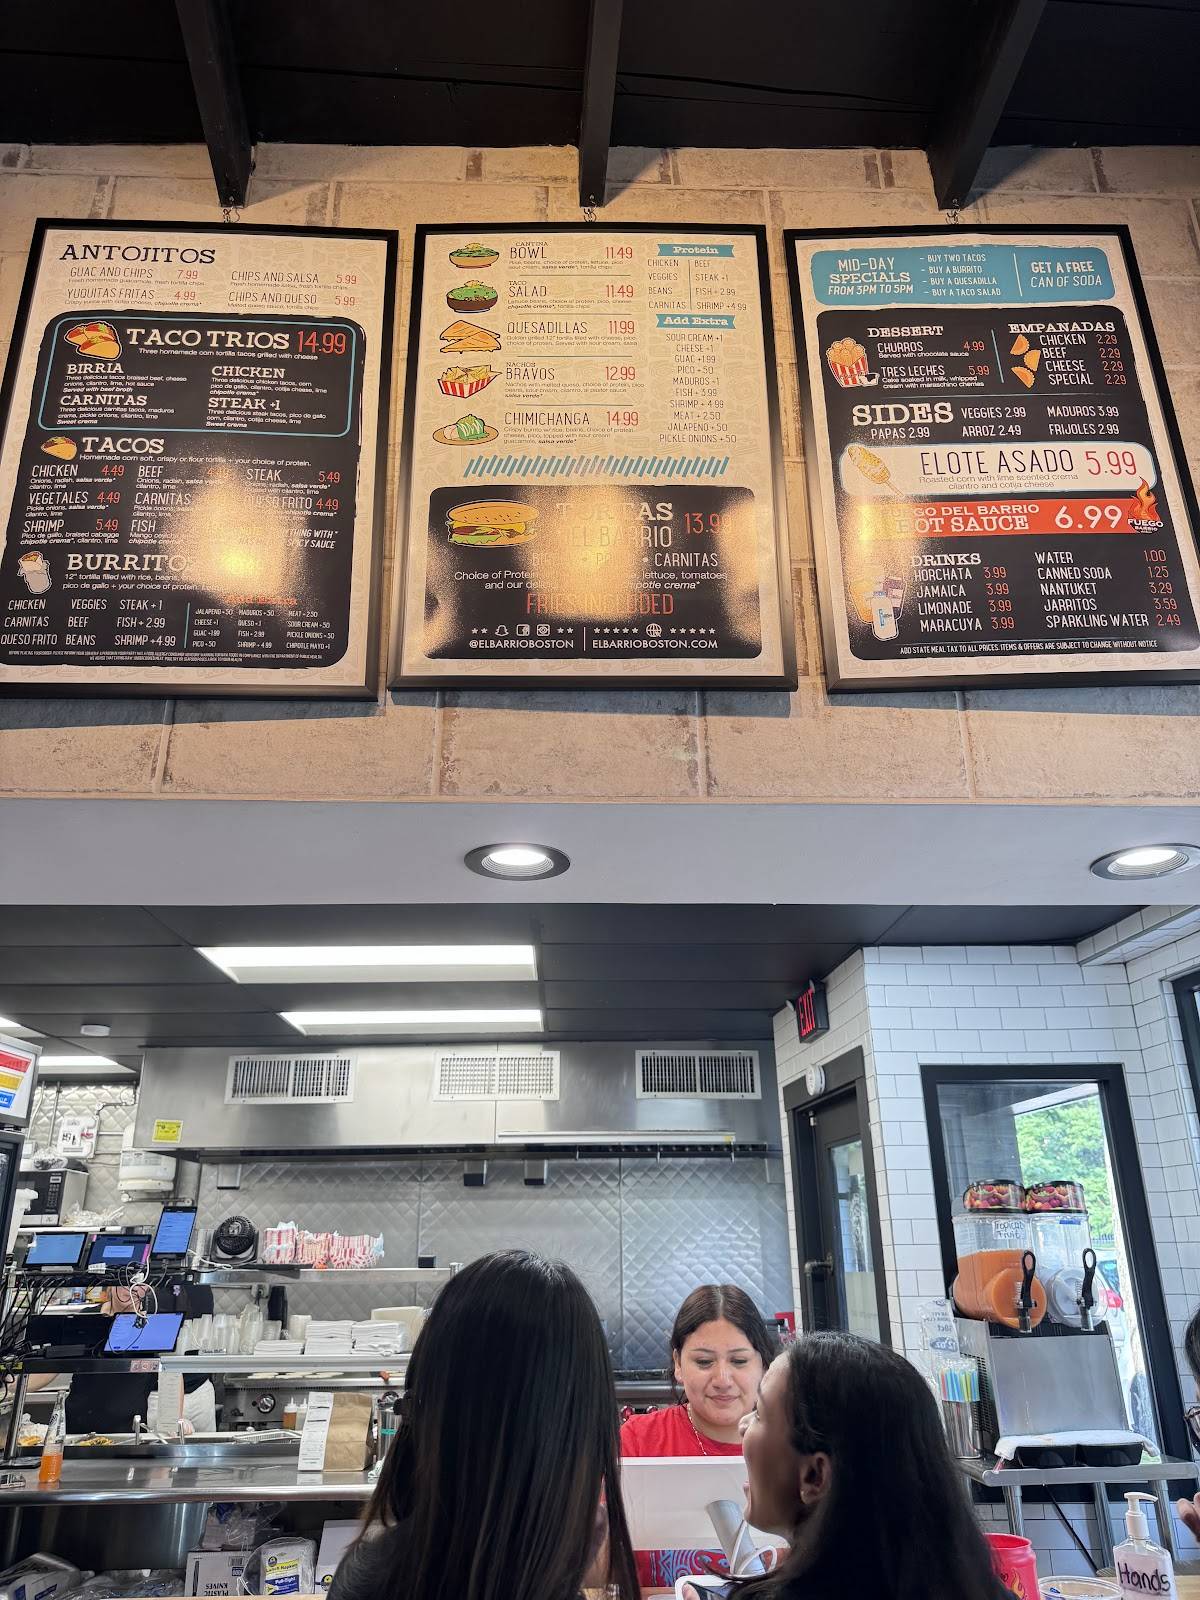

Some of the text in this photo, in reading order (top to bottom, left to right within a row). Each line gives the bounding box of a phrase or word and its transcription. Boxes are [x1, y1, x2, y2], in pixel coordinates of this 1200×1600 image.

[60, 245, 215, 263] ANTOJITOS
[510, 247, 547, 259] BOWL
[963, 254, 986, 262] TACOS
[838, 257, 894, 271] MID-DAY
[929, 266, 943, 274] BUY
[953, 266, 982, 274] BURRITO
[1031, 261, 1094, 273] GET A FREE
[70, 267, 198, 279] GUAC AND CHIPS 7.99
[231, 271, 357, 284] CHIPS AND SALSA 5.99
[830, 272, 911, 284] SPECIALS
[955, 277, 997, 285] QUESADILLA
[1031, 275, 1102, 288] CAN OF SODA
[119, 289, 196, 300] FRITAS 4.99
[508, 286, 547, 298] SALAD
[828, 285, 913, 295] FROM 3PM TO 5PM
[978, 288, 1001, 296] SALAD
[229, 292, 317, 304] CHIPS AND QUESO
[507, 321, 634, 334] QUESADILLAS 11.99
[867, 326, 943, 337] DESSERT
[1008, 322, 1115, 333] EMPANADAS
[127, 329, 346, 354] TACO TRIOS 14.99
[1040, 334, 1117, 345] CHICKEN 2.29
[878, 341, 984, 353] CHURROS 4.99
[1043, 348, 1120, 358] BEEF 2.29
[67, 363, 124, 374] BIRRIA
[212, 366, 285, 378] CHICKEN
[881, 365, 989, 377] TRES LECHES 5.99
[1046, 360, 1123, 372] CHEESE 2.29
[506, 366, 636, 380] BRAVOS 12.99
[1048, 373, 1126, 385] SPECIAL 2.29
[673, 377, 710, 385] MADUROS
[60, 395, 147, 406] CARNITAS
[208, 398, 266, 409] STEAK
[852, 402, 954, 426] SIDES
[961, 407, 1026, 418] VEGGIES 2.99
[1047, 406, 1119, 417] MADUROS 3.99
[504, 412, 639, 426] CHIMICHANGA 14.99
[871, 427, 930, 439] PAPAS 2.99
[962, 425, 1021, 436] ARROZ 2.49
[1049, 424, 1119, 435] FRIJOLES 2.99
[82, 437, 164, 454] TACOS
[921, 450, 1136, 476] ELOTE ASADO 5.99
[32, 465, 124, 477] CHICKEN 4.49
[138, 466, 164, 477] BEEF
[246, 469, 340, 483] STEAK 5.49
[29, 492, 120, 504] VEGETALES 4.49
[283, 497, 312, 510] FRITO
[942, 504, 1039, 516] DEL BARRIO
[1055, 505, 1122, 529] 6.99
[1128, 519, 1163, 527] FUEGO
[23, 519, 118, 532] SHRIMP 5.49
[131, 520, 156, 532] FISH
[951, 515, 1029, 532] SAUCE
[654, 553, 718, 567] CARNITAS
[912, 553, 981, 567] DRINKS
[1035, 550, 1167, 564] WATER 1.00
[455, 571, 501, 580] Choice of
[914, 567, 1007, 581] HORCHATA 3.99
[1038, 566, 1169, 580] CANNED SODA 1.25
[485, 581, 503, 589] and
[917, 583, 1009, 598] JAMAICA 3.99
[1040, 582, 1172, 595] NANTUKET 3.29
[8, 599, 46, 610] CHICKEN
[71, 599, 107, 609] VEGGIES
[120, 600, 148, 610] STEAK
[918, 600, 1012, 615] LIMONADE 3.99
[1044, 599, 1177, 612] JARRITOS 3.59
[5, 617, 49, 627] CARNITAS
[68, 617, 89, 627] BEEF
[117, 618, 137, 627] FISH
[920, 617, 1015, 632] MARACUYA 3.99
[1046, 614, 1180, 628] SPARKLING WATER 2.49
[1, 635, 57, 645] QUESO FRITO
[66, 635, 96, 645] BEANS
[115, 635, 148, 645] SHRIMP
[469, 640, 573, 649] @ELBARRIOBOSTON
[593, 640, 717, 648] ELBARRIOBOSTON.COM
[913, 646, 930, 654] STATE
[798, 989, 815, 1036] EXIT
[1117, 1562, 1170, 1592] Hands
